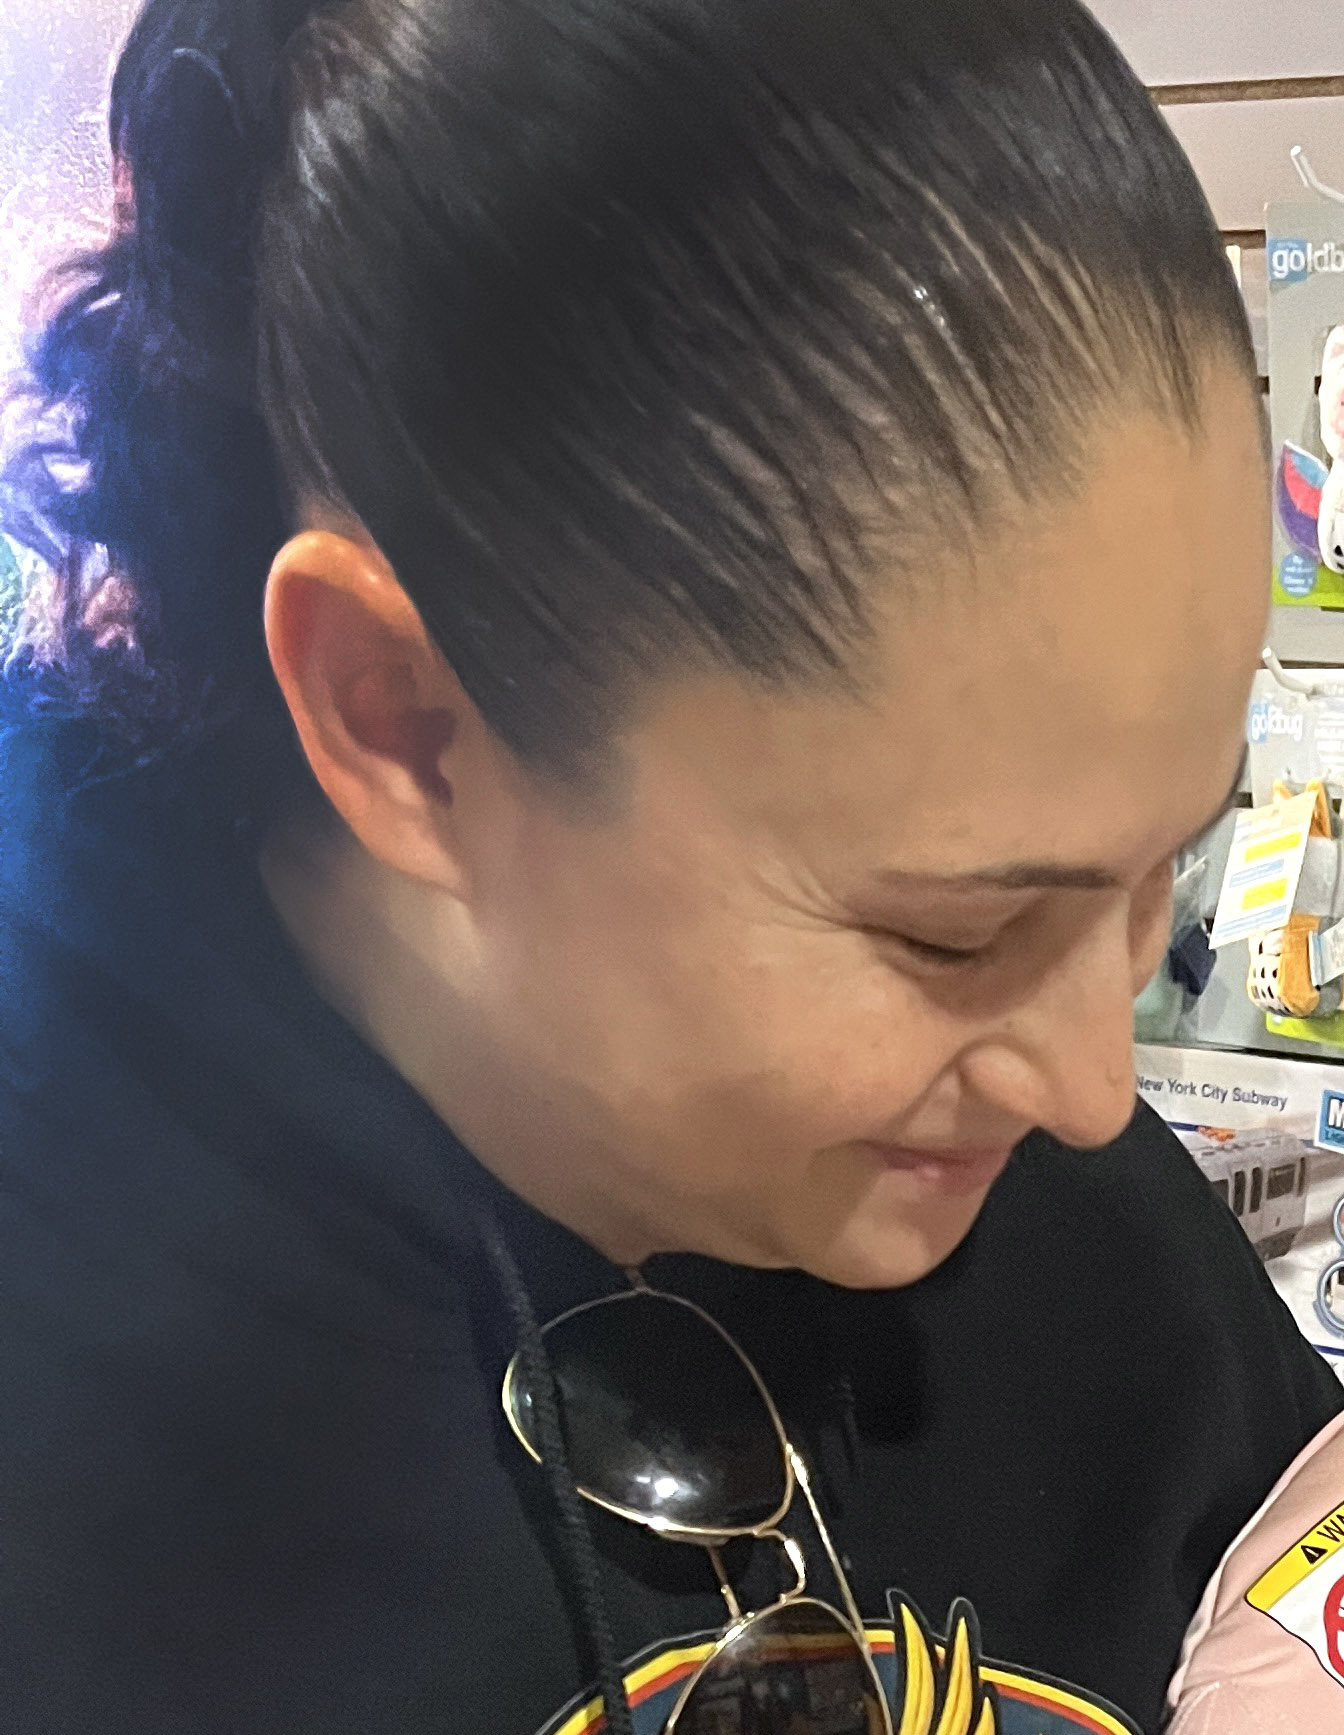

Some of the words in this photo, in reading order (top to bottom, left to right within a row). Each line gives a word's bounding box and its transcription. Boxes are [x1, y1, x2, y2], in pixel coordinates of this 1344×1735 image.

[1168, 1078, 1197, 1097] York
[1201, 1083, 1228, 1105] City
[1232, 1086, 1289, 1112] Subway
